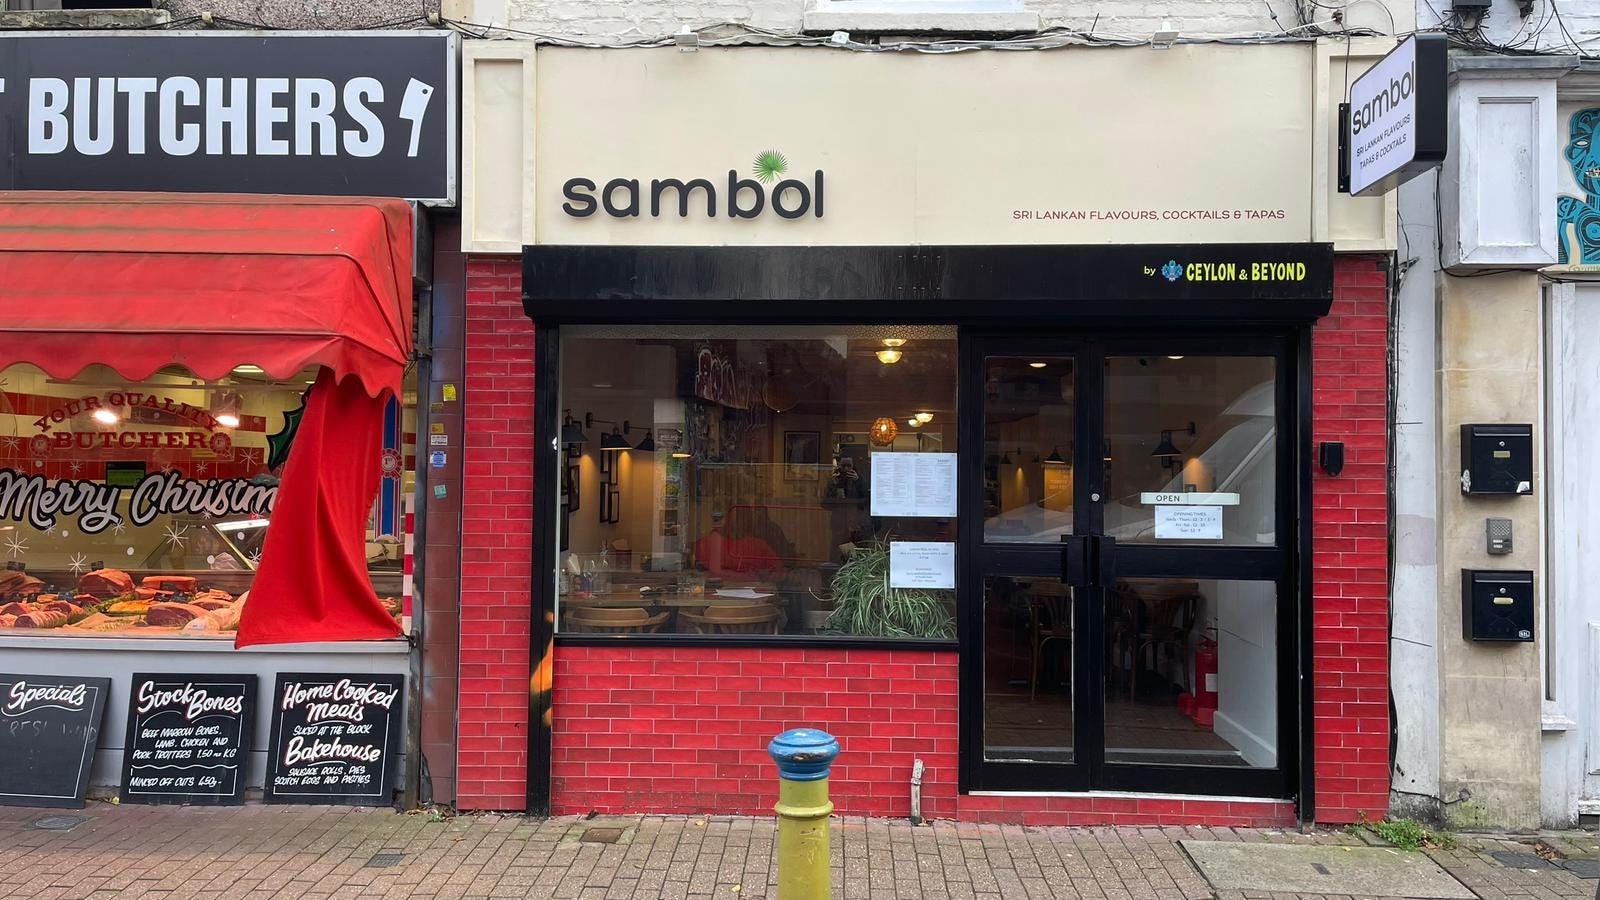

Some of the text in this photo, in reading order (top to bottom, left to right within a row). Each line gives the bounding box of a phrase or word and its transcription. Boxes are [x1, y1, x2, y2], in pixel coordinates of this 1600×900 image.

[1352, 61, 1414, 136] sambol
[28, 76, 385, 157] BUTCHERS
[1364, 134, 1384, 152] LANKAN
[1384, 114, 1410, 139] FLAVOURS
[1360, 154, 1375, 169] TAPAS
[1380, 134, 1407, 157] COCKTAILS
[562, 169, 824, 220] sambol
[1013, 210, 1285, 221] SRI LANKAN FLAVOURS, COCKTAILS & TAPAS
[1144, 262, 1306, 281] by CEYLON & BEYOND
[34, 392, 220, 432] YOUR QUALITY
[52, 432, 209, 450] BUTCHER
[0, 470, 279, 534] Merry Christm
[7, 681, 87, 710] Specials
[138, 681, 244, 719] Stock Bones
[283, 679, 398, 710] Home Cooked
[306, 701, 365, 723] Meats
[141, 729, 159, 738] BEEF
[160, 728, 193, 738] MARROW
[181, 738, 209, 747] CHICKEN
[212, 737, 229, 746] AND
[293, 724, 372, 736] SLICED AT THE BLOCK
[133, 750, 152, 759] PORK
[154, 750, 192, 759] TROTTERS
[223, 748, 236, 758] KG
[285, 736, 381, 766] Bakehouse
[130, 777, 159, 786] MINCED
[159, 778, 175, 786] OFF
[175, 777, 194, 786] CUTS
[274, 777, 300, 786] SCOTCH
[301, 776, 321, 785] EGGS
[341, 775, 370, 784] PASTIES
[288, 768, 318, 776] SAUSAGE
[348, 766, 366, 774] PIES
